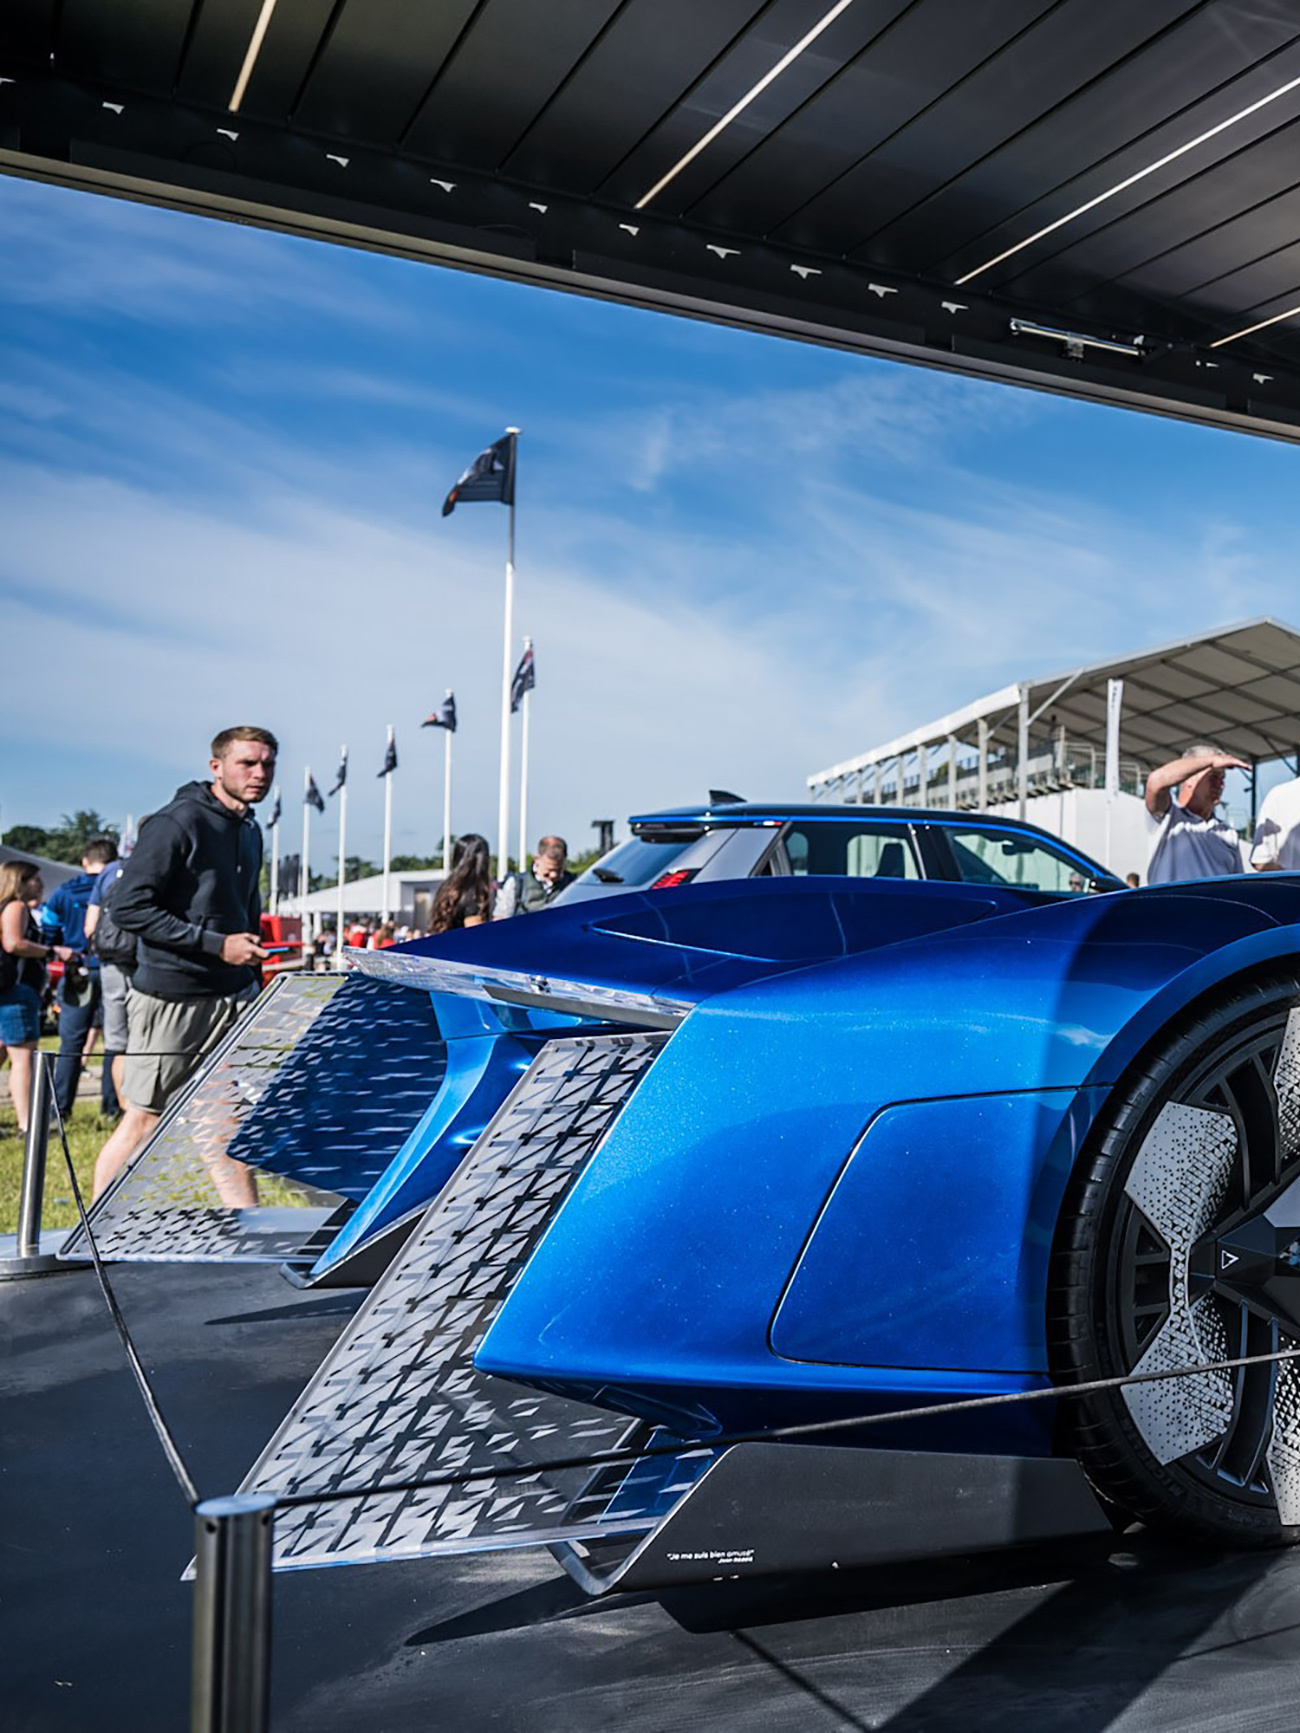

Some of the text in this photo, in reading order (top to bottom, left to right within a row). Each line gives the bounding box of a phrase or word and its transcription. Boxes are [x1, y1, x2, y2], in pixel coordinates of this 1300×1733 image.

[681, 1552, 693, 1560] me
[694, 1551, 709, 1559] suis
[710, 1550, 726, 1558] bien
